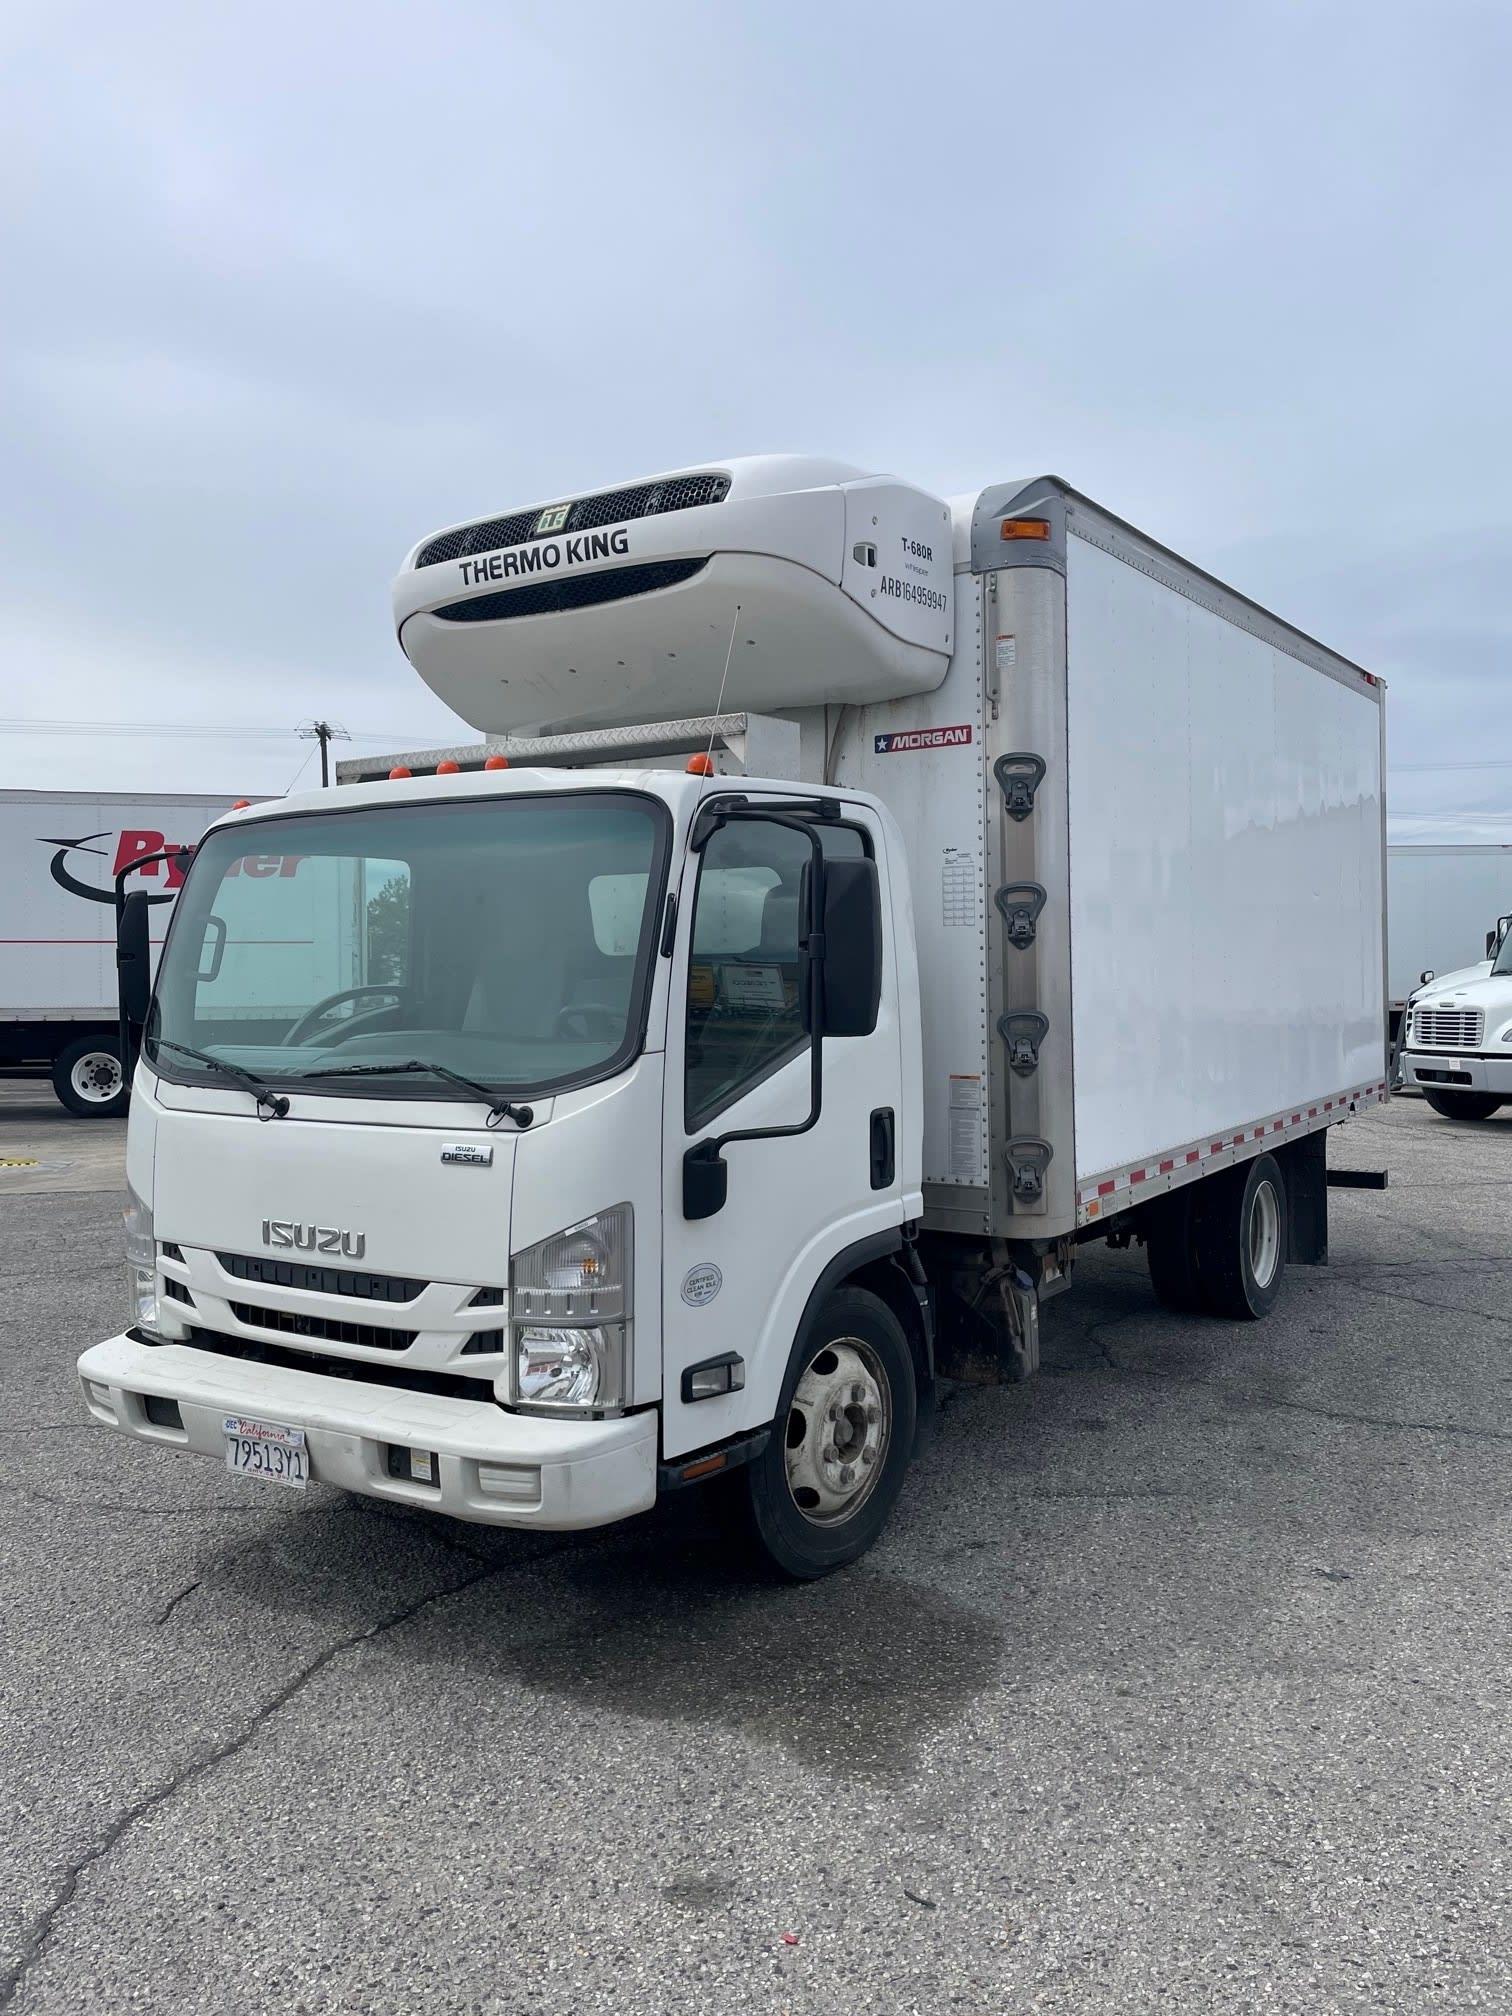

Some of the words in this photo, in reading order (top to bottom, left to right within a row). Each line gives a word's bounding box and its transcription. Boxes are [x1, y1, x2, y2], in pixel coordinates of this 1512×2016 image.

[459, 543, 560, 585] THERMO
[566, 528, 629, 564] KING
[901, 537, 932, 562] T-680R
[880, 575, 947, 612] ARB164959947
[891, 728, 967, 750] MORGAN
[112, 830, 311, 888] Ryer
[442, 1152, 488, 1164] DIESEL
[262, 1218, 366, 1260] ISUZU
[686, 1284, 704, 1294] CLEAN
[689, 1274, 714, 1286] CERTIFIED
[240, 1420, 290, 1443] California
[229, 1437, 304, 1480] 79513Y1
